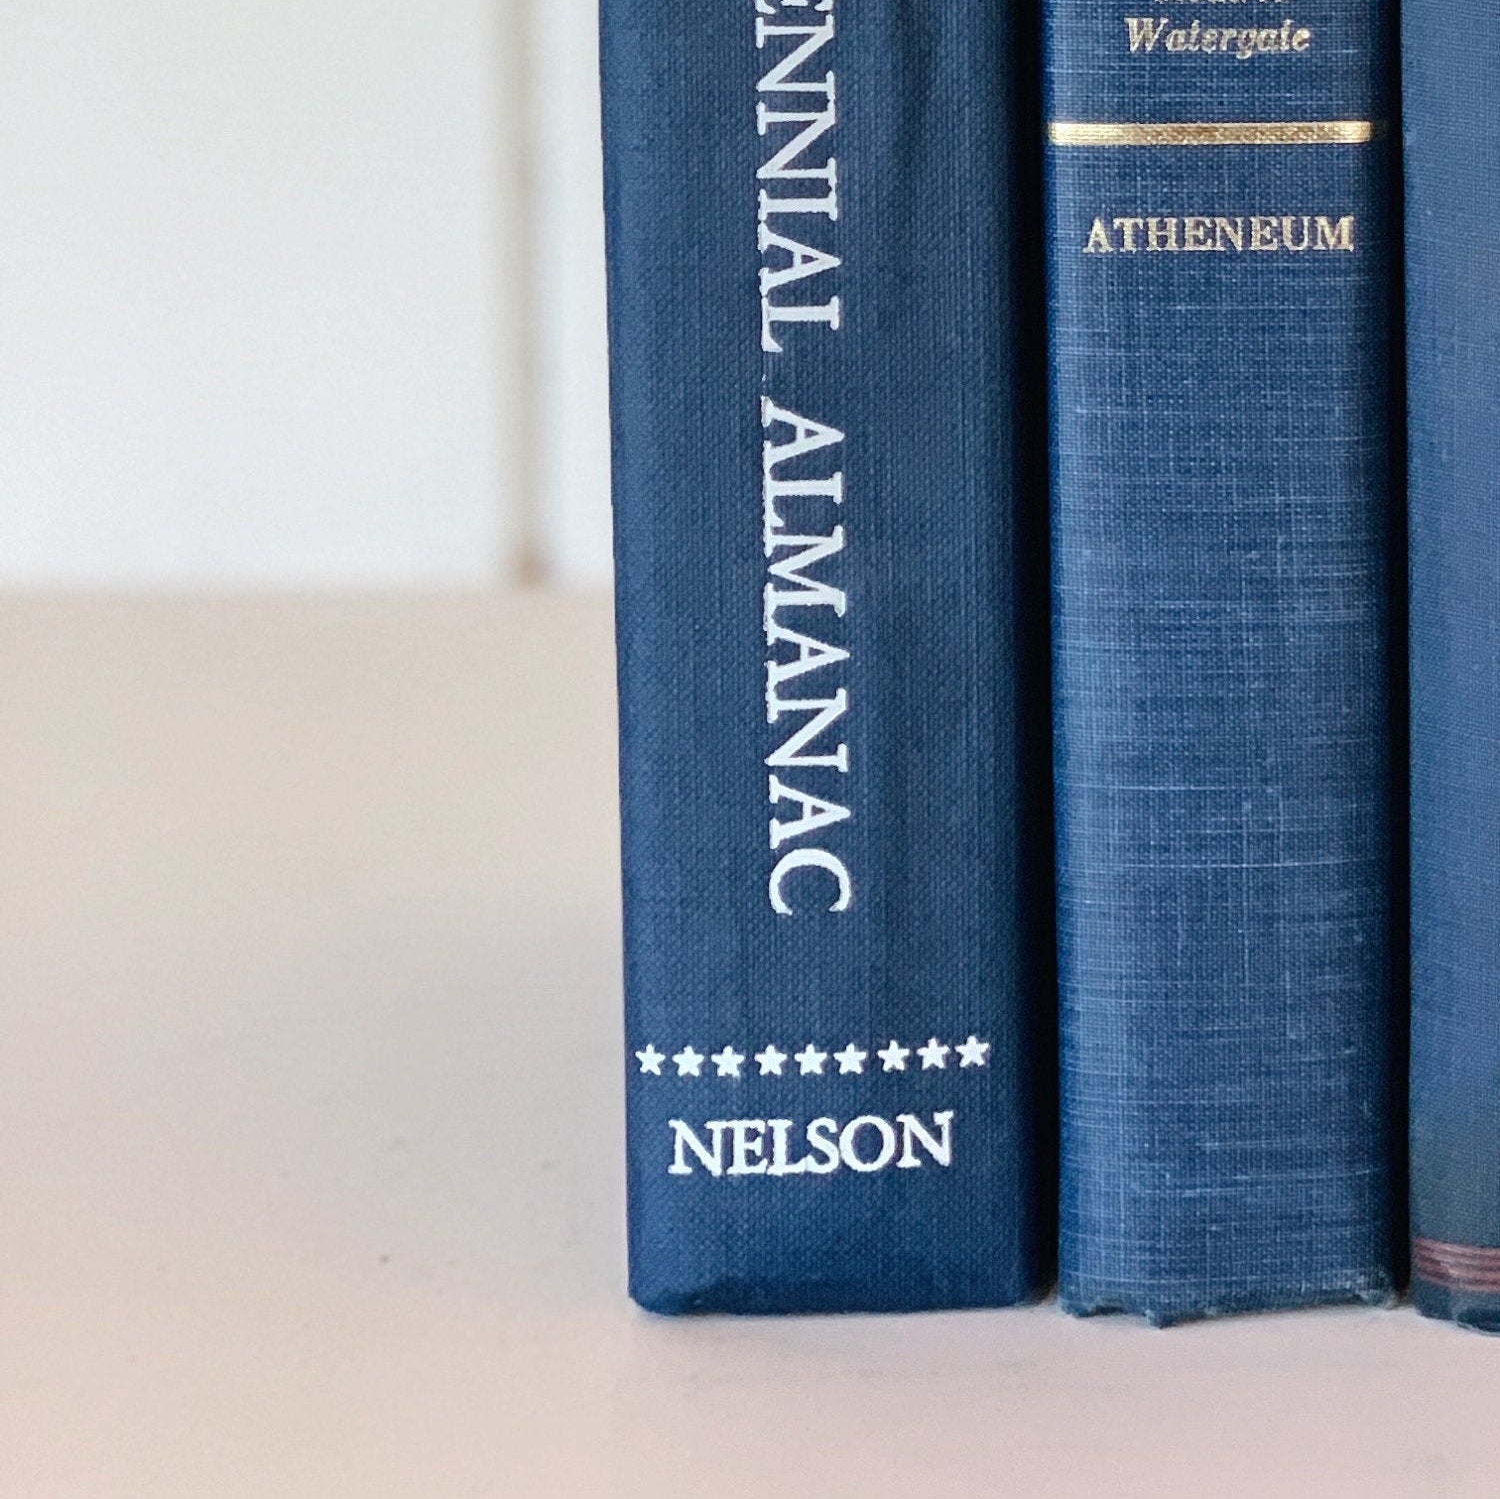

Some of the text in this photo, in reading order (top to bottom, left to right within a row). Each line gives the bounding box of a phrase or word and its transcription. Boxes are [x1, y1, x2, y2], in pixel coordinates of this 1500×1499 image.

[1124, 17, 1312, 59] Watergate
[1082, 217, 1354, 253] ATHENEUM
[760, 395, 852, 916] ALMANAC
[669, 1111, 954, 1178] NELSON
